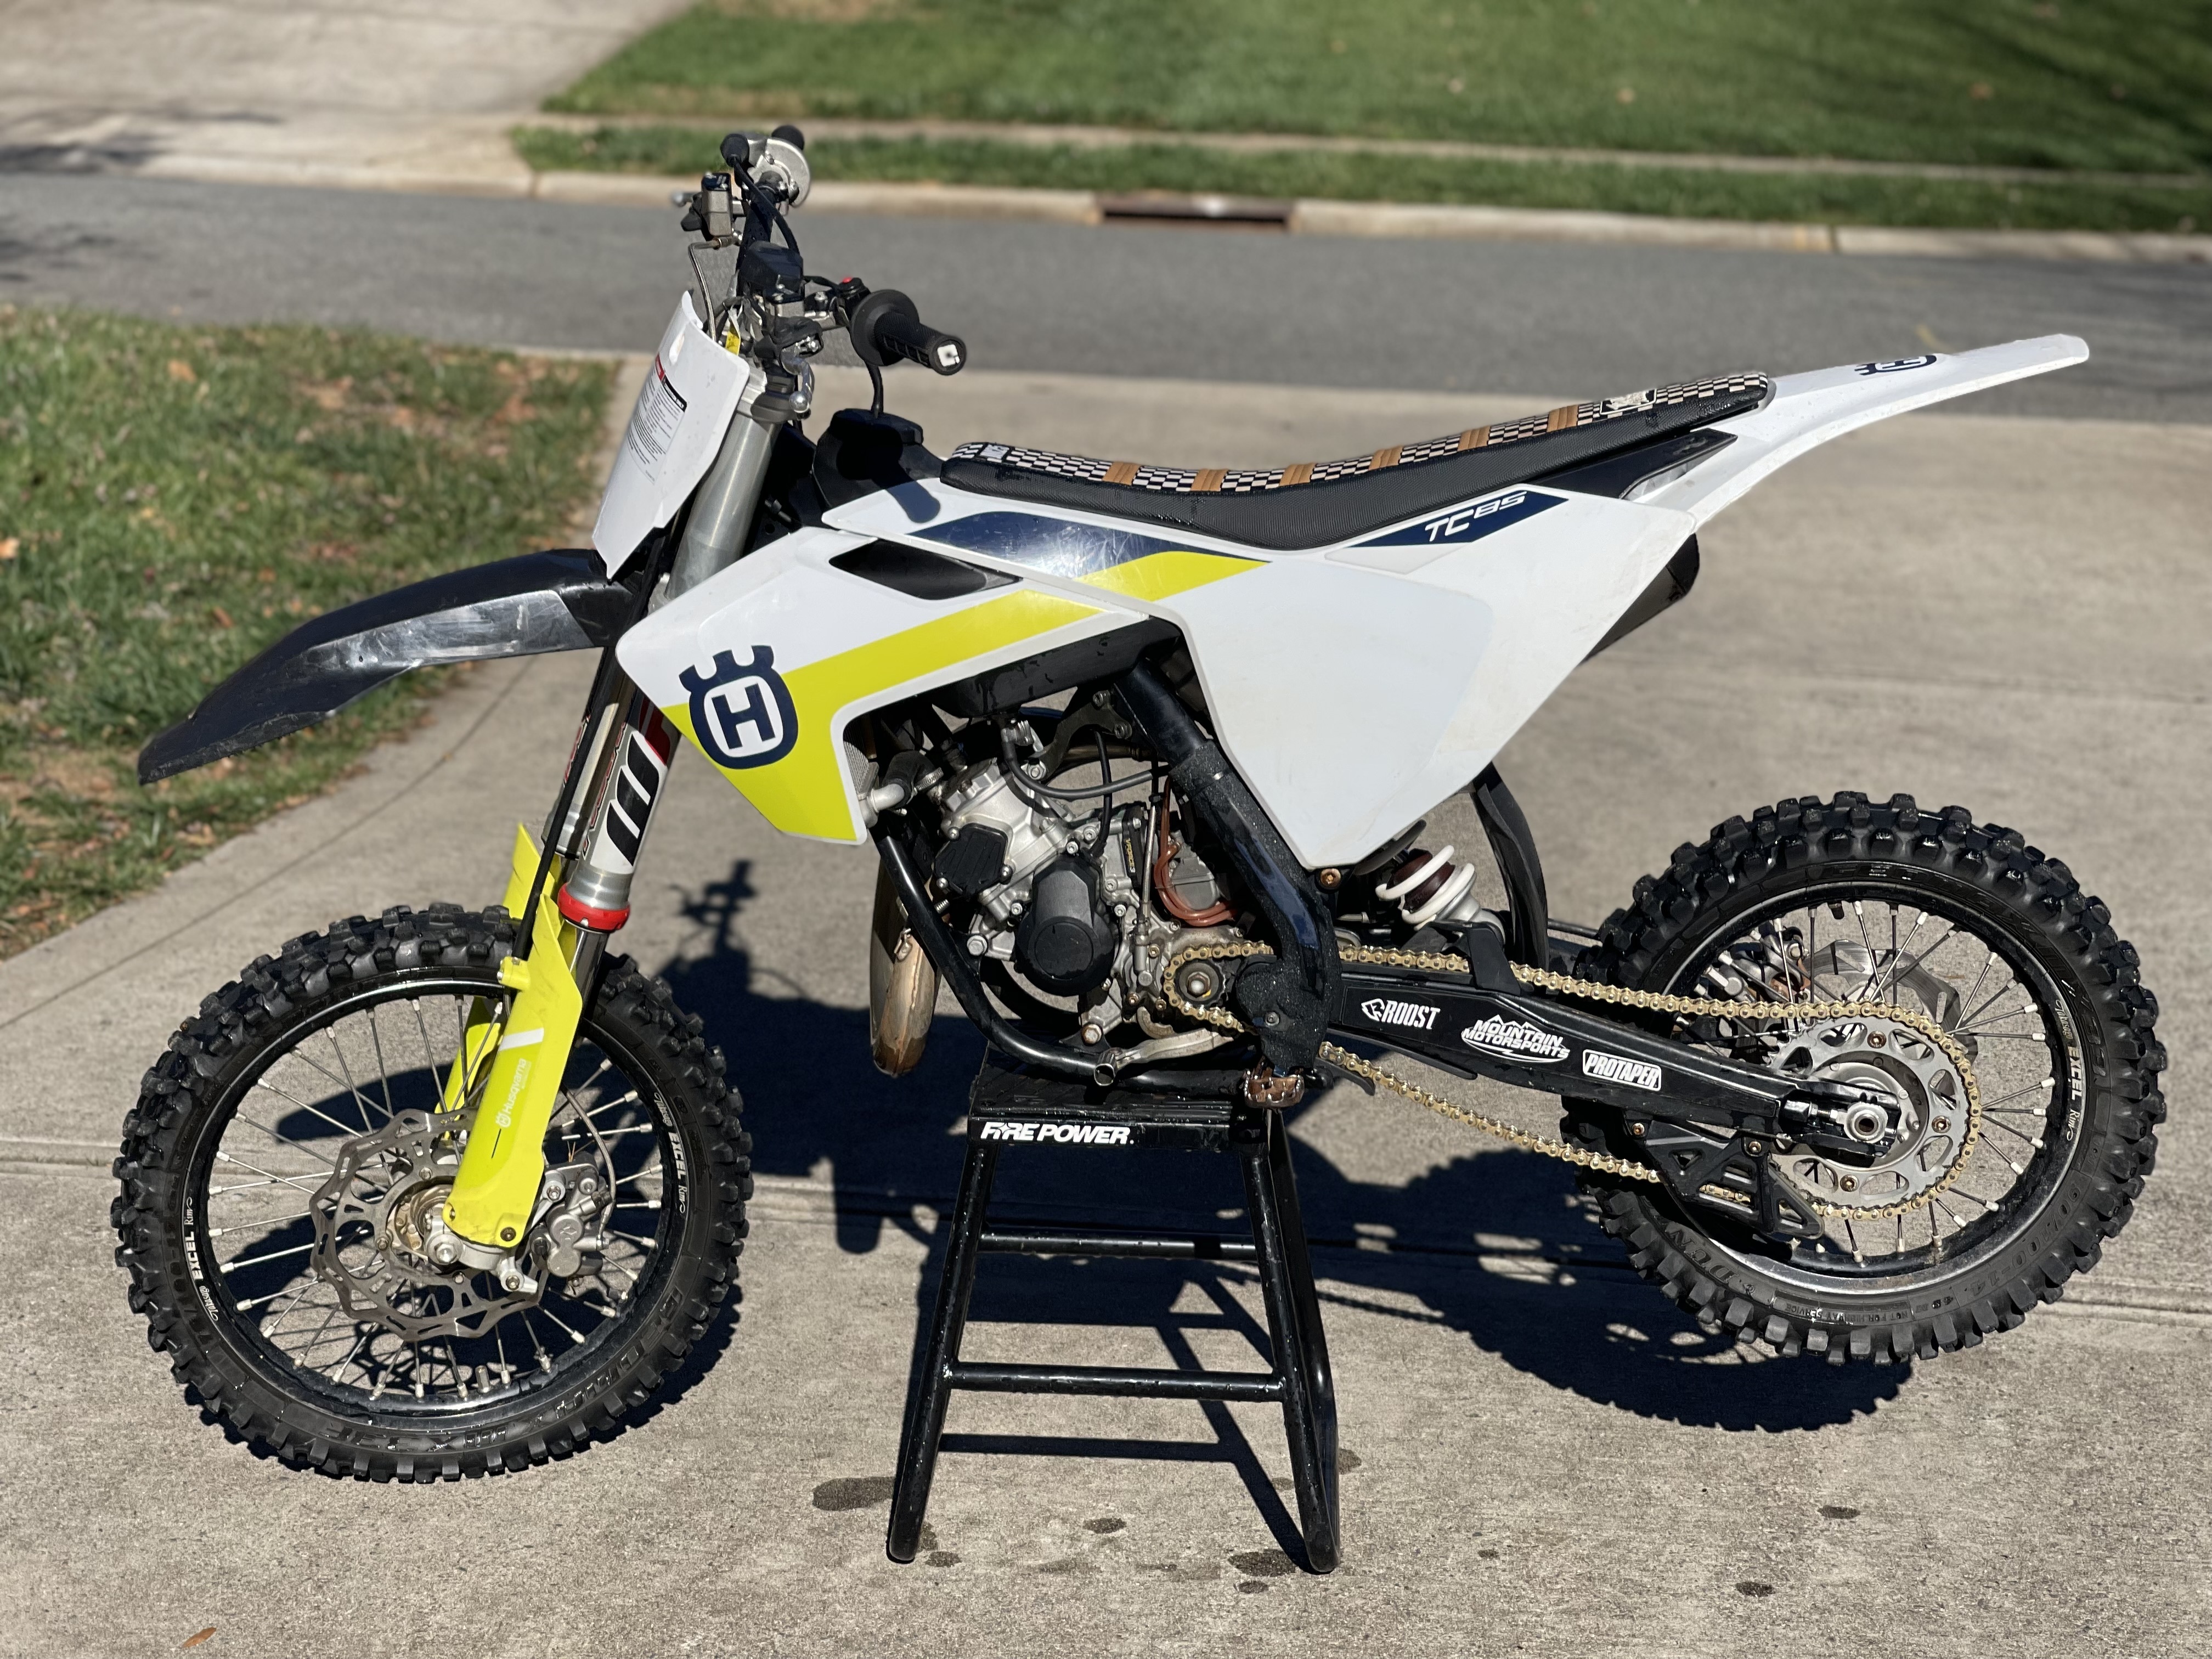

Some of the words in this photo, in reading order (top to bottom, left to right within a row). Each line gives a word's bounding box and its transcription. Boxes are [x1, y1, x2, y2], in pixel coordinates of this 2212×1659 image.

[1424, 491, 1527, 542] TC85
[1381, 1000, 1441, 1030] ROOST
[1461, 1028, 1571, 1059] MOTORSPORTS
[1474, 1019, 1564, 1047] MOUNTAIN
[501, 1057, 527, 1114] Husqvarna
[1584, 1053, 1660, 1088] PROTAPER
[2068, 1046, 2083, 1101] EXCEL
[980, 1121, 1040, 1141] FIRE
[1036, 1124, 1131, 1144] POWER
[2067, 1108, 2081, 1141] Rim
[668, 1131, 686, 1180] EXCEL
[184, 1231, 204, 1281] EXCEL
[1784, 1303, 1823, 1321] SERVICE
[1890, 1310, 1908, 1322] NOT
